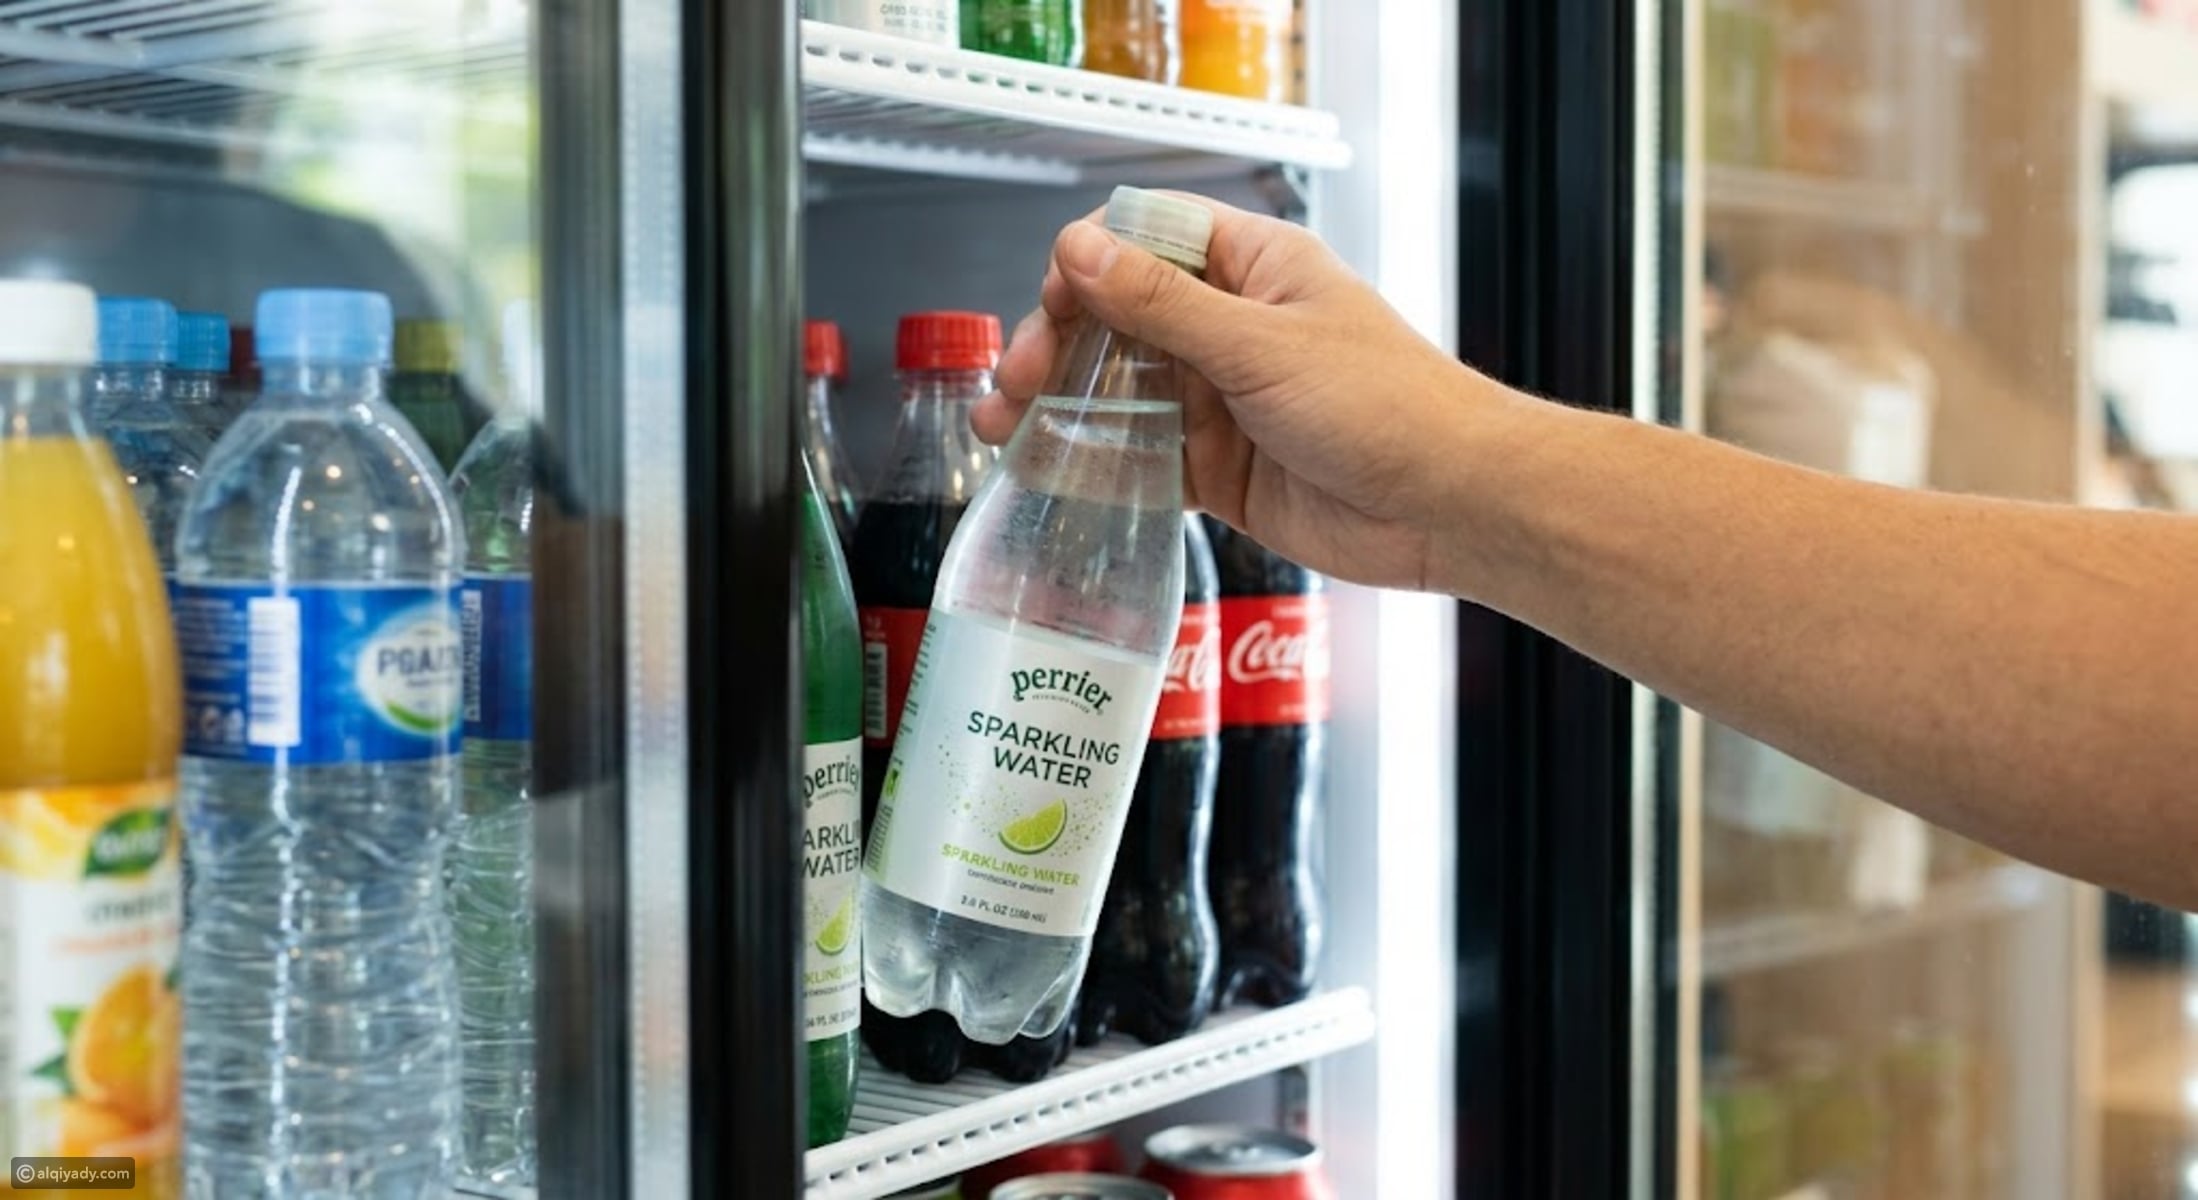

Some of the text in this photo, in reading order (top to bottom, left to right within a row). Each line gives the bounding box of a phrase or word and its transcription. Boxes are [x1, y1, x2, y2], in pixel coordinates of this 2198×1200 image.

[1011, 668, 1112, 710] perrier
[967, 711, 1121, 765] SPARKLING
[994, 747, 1092, 788] WATER
[1034, 867, 1080, 887] WATER
